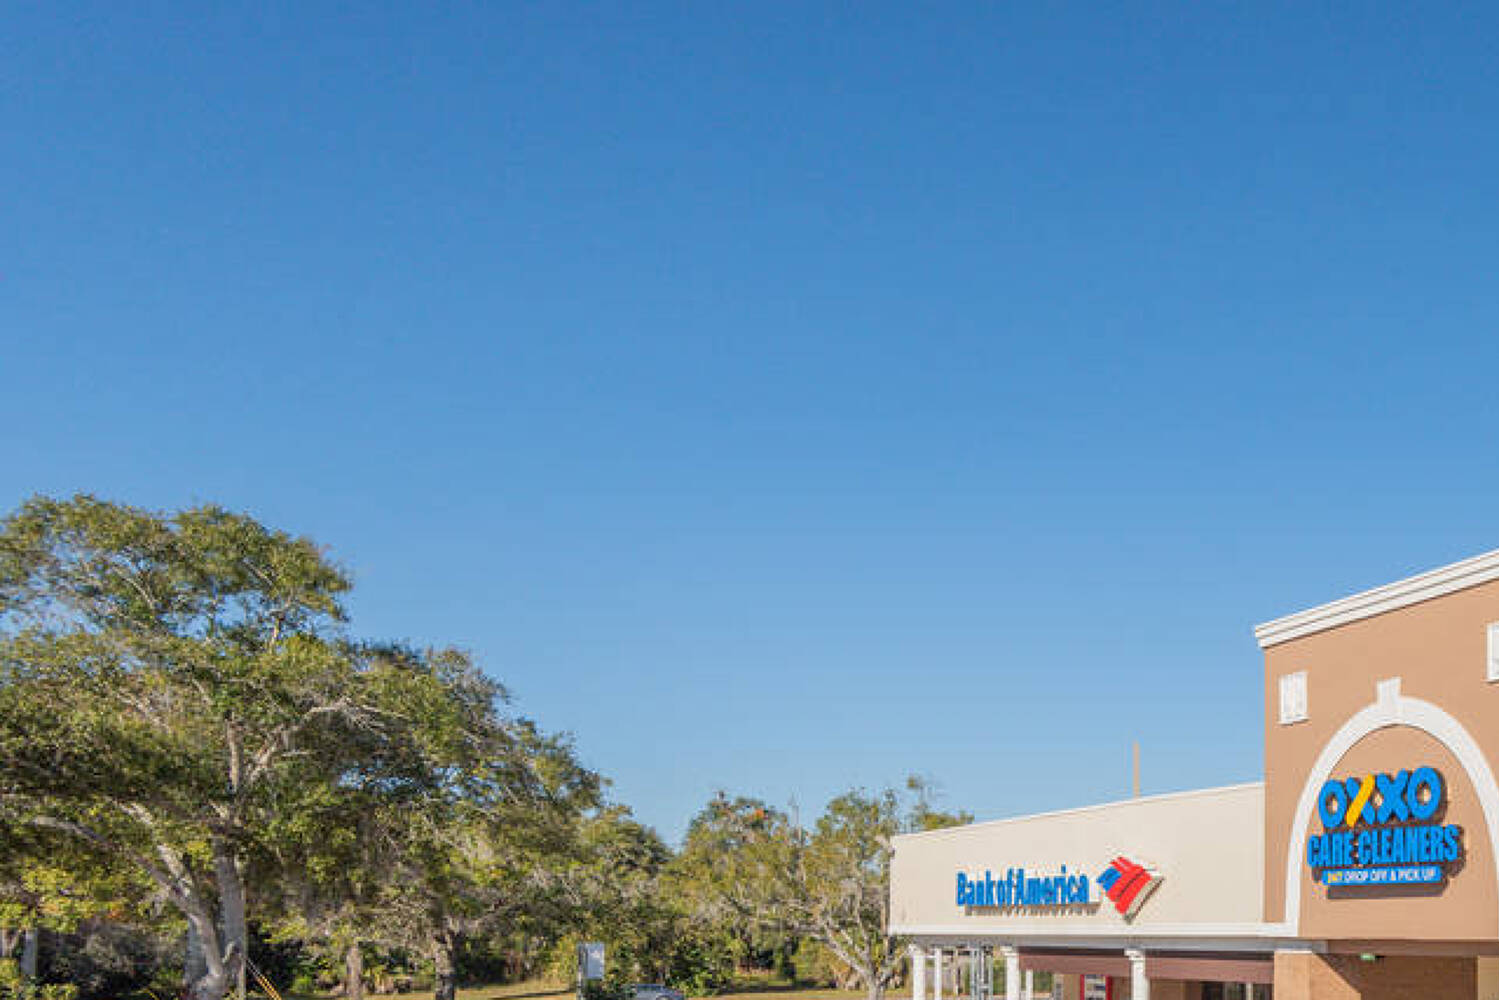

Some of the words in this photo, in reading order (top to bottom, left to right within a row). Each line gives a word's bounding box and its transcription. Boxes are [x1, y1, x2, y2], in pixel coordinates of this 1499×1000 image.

[1318, 766, 1442, 830] OXXO
[1358, 824, 1460, 864] CLEANERS
[957, 869, 995, 905] Bank
[1015, 864, 1090, 905] America
